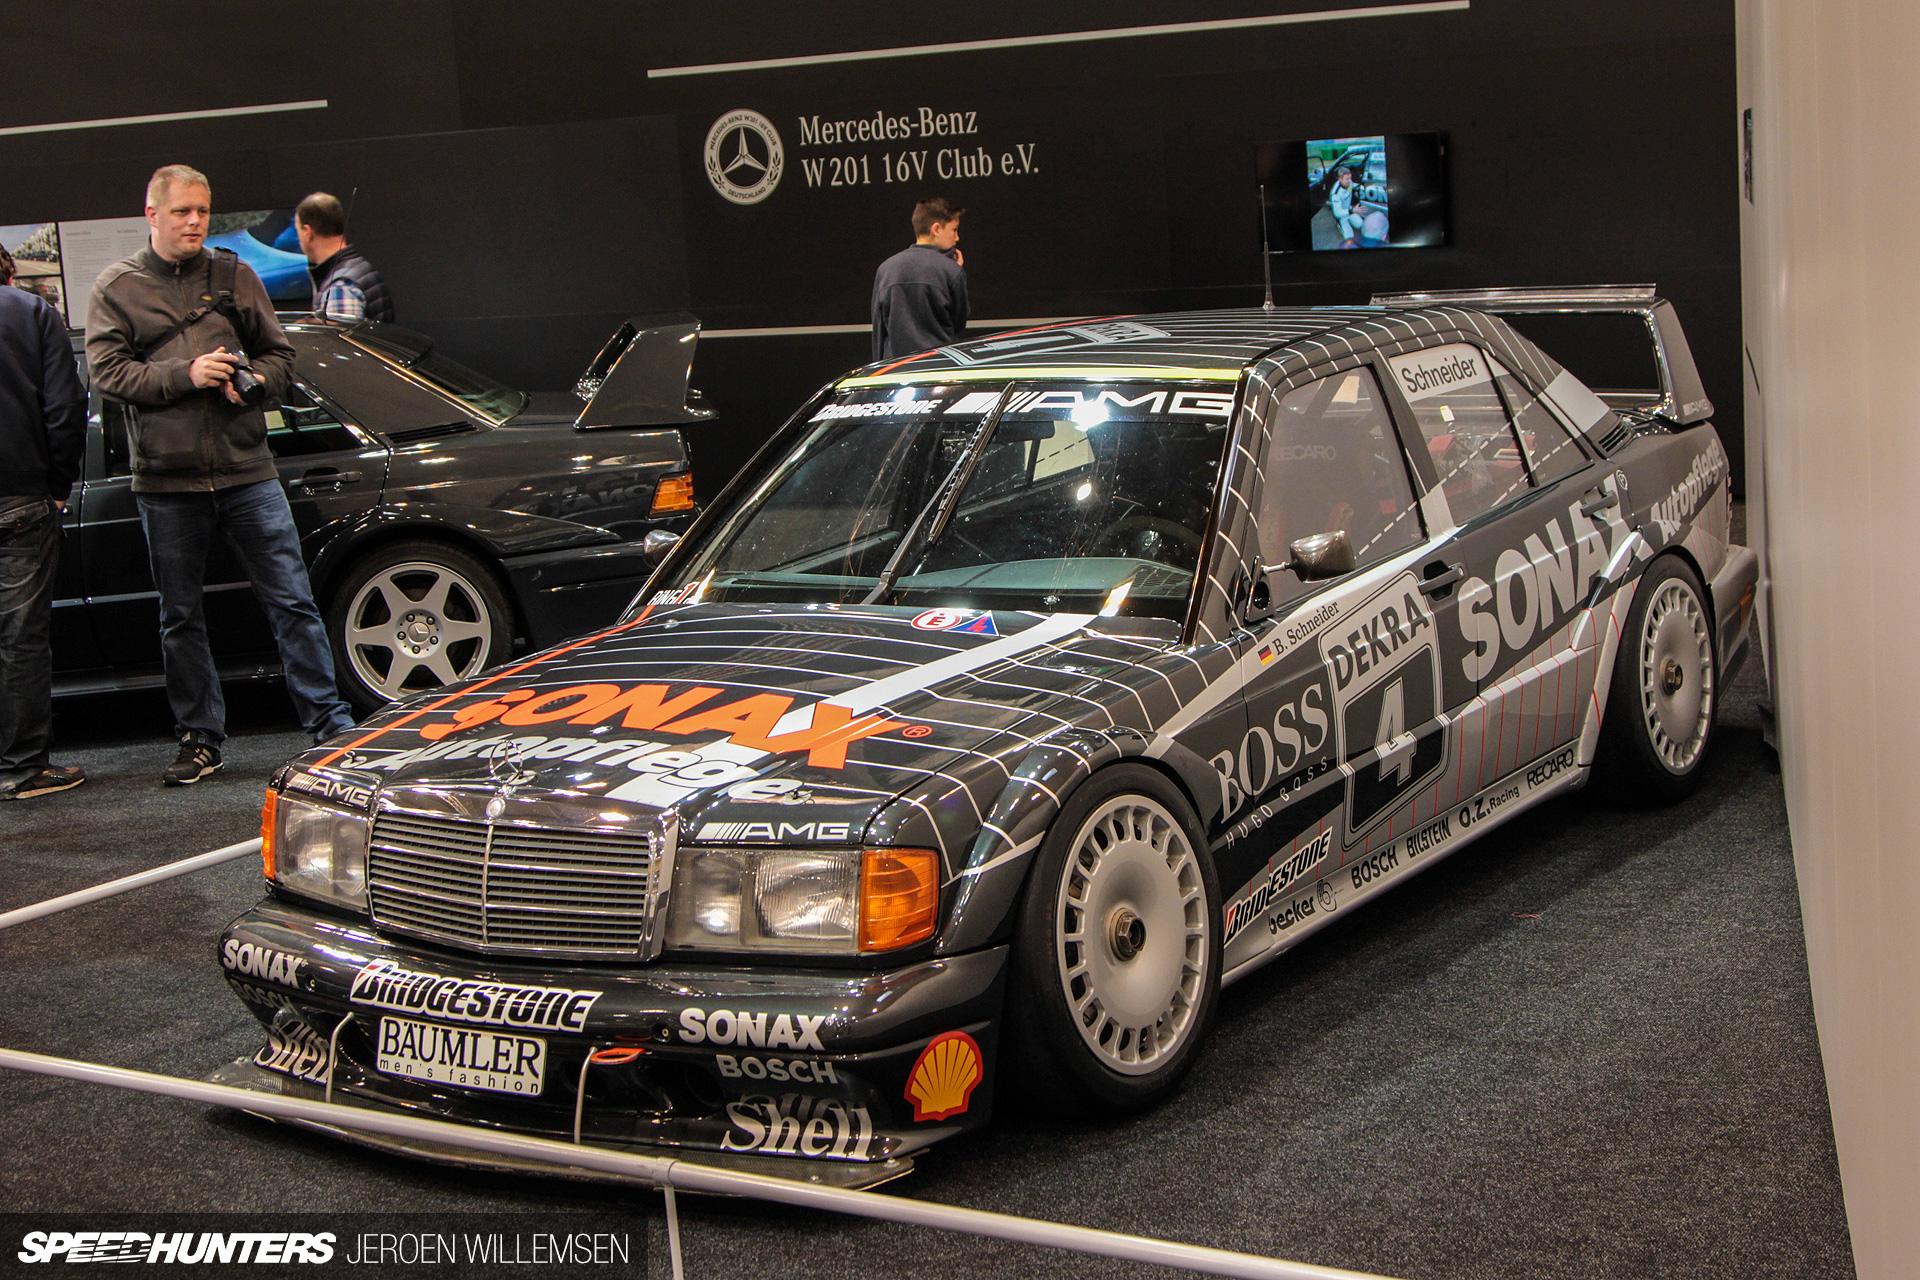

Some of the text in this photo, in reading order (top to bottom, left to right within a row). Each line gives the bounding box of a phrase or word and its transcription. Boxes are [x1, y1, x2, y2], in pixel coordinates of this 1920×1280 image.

[766, 129, 777, 146] CLUB
[799, 106, 978, 146] Mercedes-Benz
[882, 150, 929, 184] 16V
[937, 147, 993, 180] Club
[1000, 143, 1040, 175] e.V.
[727, 186, 766, 199] DEUTSCHLAND
[1401, 355, 1477, 393] Schneider
[808, 399, 943, 422] BRIDGESTONE
[1025, 391, 1234, 417] AMG
[1651, 438, 1724, 545] Autopflege
[1272, 600, 1341, 656] B. Schneider
[1327, 592, 1429, 693] DEKRA
[1374, 677, 1418, 787] 4
[1208, 683, 1330, 825] BOSS
[308, 777, 373, 808] AMG
[1226, 756, 1328, 850] HUGO BOSS
[738, 822, 850, 840] AMG
[1269, 896, 1316, 935] becker
[1351, 845, 1399, 889] BOSCH
[1406, 817, 1452, 858] BILSTEIN
[1527, 749, 1574, 789] RECARO
[229, 978, 299, 1015] BOSCH
[351, 958, 603, 1033] BRIDGESTONE
[381, 1017, 541, 1079] BÄUMLER
[380, 1058, 538, 1093] men's fashion
[716, 1054, 838, 1084] BOSCH
[720, 1101, 869, 1162] Shell
